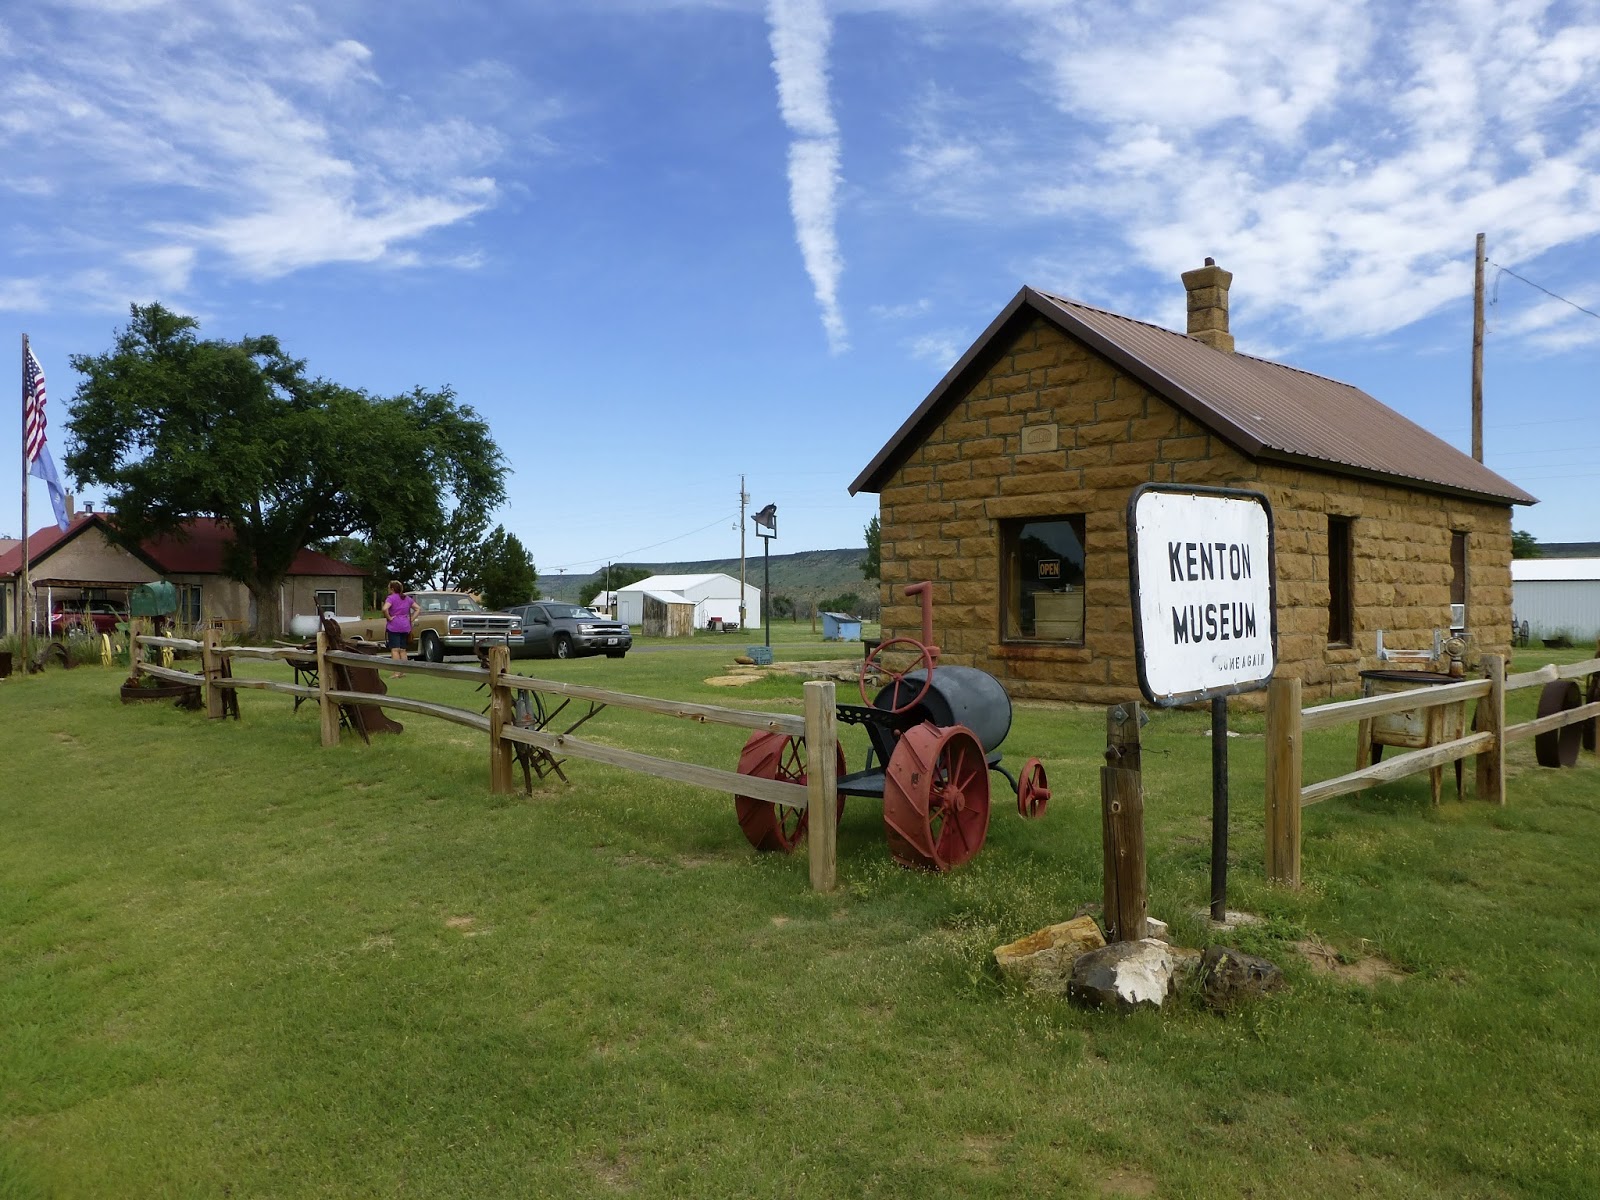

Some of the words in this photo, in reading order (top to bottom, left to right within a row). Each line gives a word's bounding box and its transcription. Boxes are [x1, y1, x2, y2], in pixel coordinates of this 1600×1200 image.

[1039, 563, 1059, 576] OPEN
[1168, 541, 1251, 582] KENTON
[1172, 602, 1256, 645] MUSEUM
[1241, 653, 1265, 669] AGAIN
